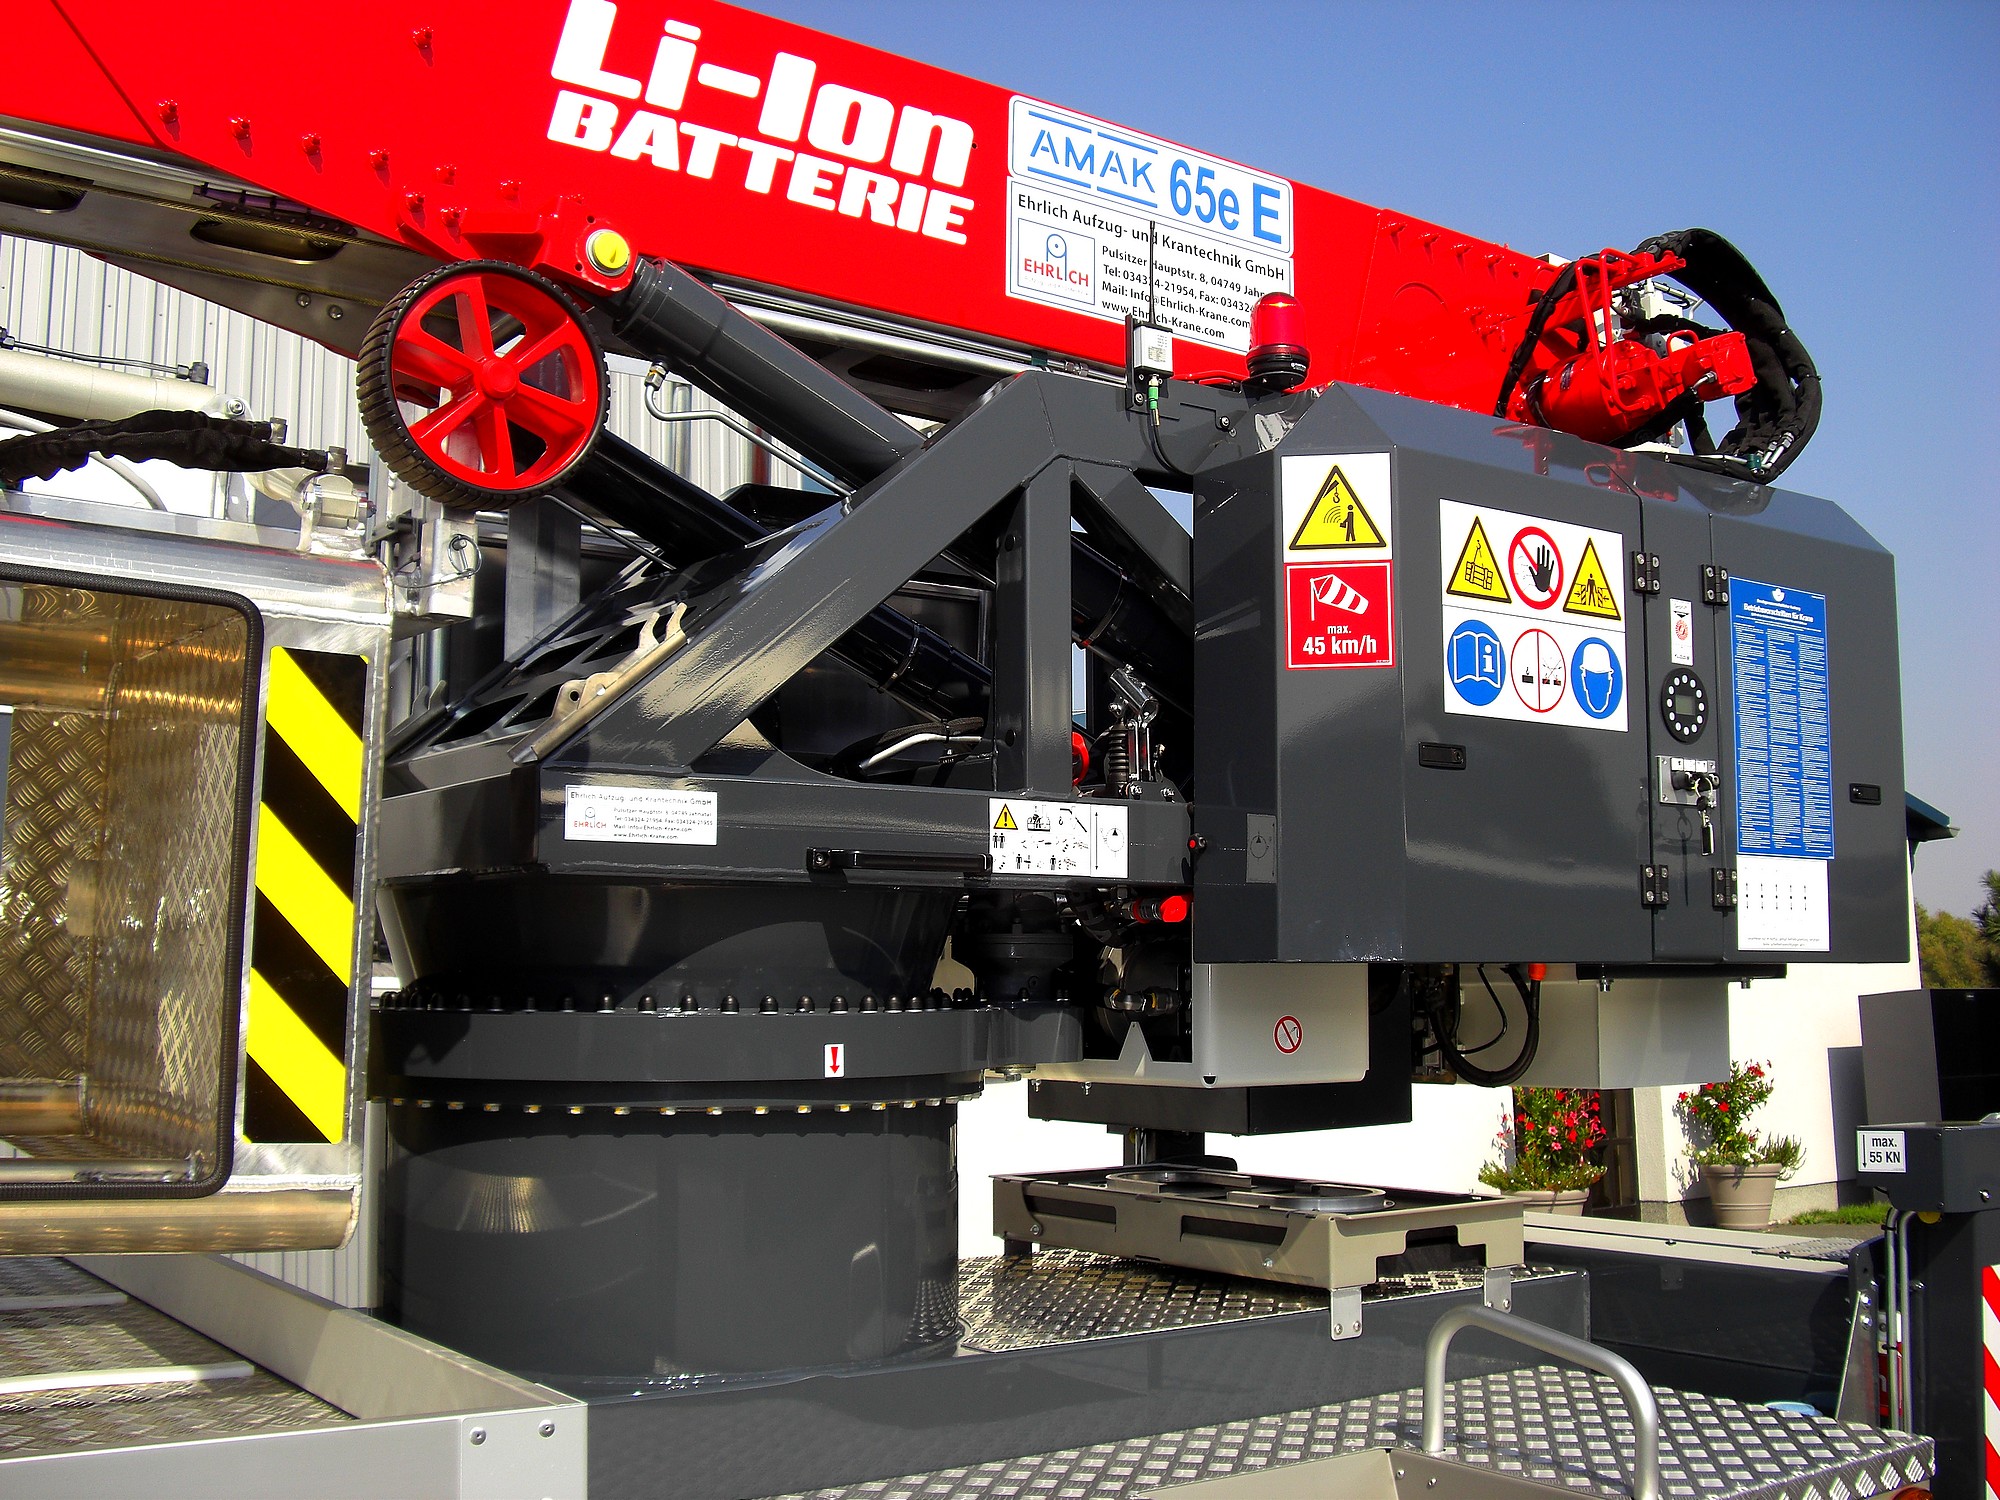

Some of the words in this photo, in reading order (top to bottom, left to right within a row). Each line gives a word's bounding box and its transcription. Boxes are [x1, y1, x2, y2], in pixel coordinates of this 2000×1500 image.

[551, 0, 974, 187] Li-Ion
[547, 89, 975, 245] BATTERIE
[1030, 129, 1156, 194] AMAK
[1170, 159, 1240, 231] 65e
[1252, 182, 1282, 244] E
[1018, 194, 1068, 220] Ehrlich
[1072, 209, 1128, 239] Aufzug-
[1132, 229, 1158, 245] und
[1162, 233, 1242, 269] Krantechnik
[1245, 259, 1284, 281] GmbH
[1024, 257, 1089, 287] EHRLICH
[1102, 245, 1148, 267] Pulsitzer
[1153, 259, 1198, 282] Hauptstr.
[1199, 273, 1208, 285] 8,
[1210, 276, 1241, 293] 04749
[1103, 263, 1121, 278] Tel:
[1122, 269, 1197, 299] 03434-21954,
[1199, 291, 1219, 305] Fax:
[1102, 280, 1127, 297] Mail:
[1101, 300, 1225, 339] www.Ehrch-Krane.com
[1327, 624, 1352, 635] max.
[1302, 636, 1326, 656] 45
[1331, 634, 1377, 656] km/h
[570, 791, 597, 799] Ehrlich
[573, 820, 607, 829] EHRLICH
[1869, 1151, 1883, 1163] 55
[1886, 1151, 1901, 1163] KN
[1871, 1137, 1898, 1147] max.
